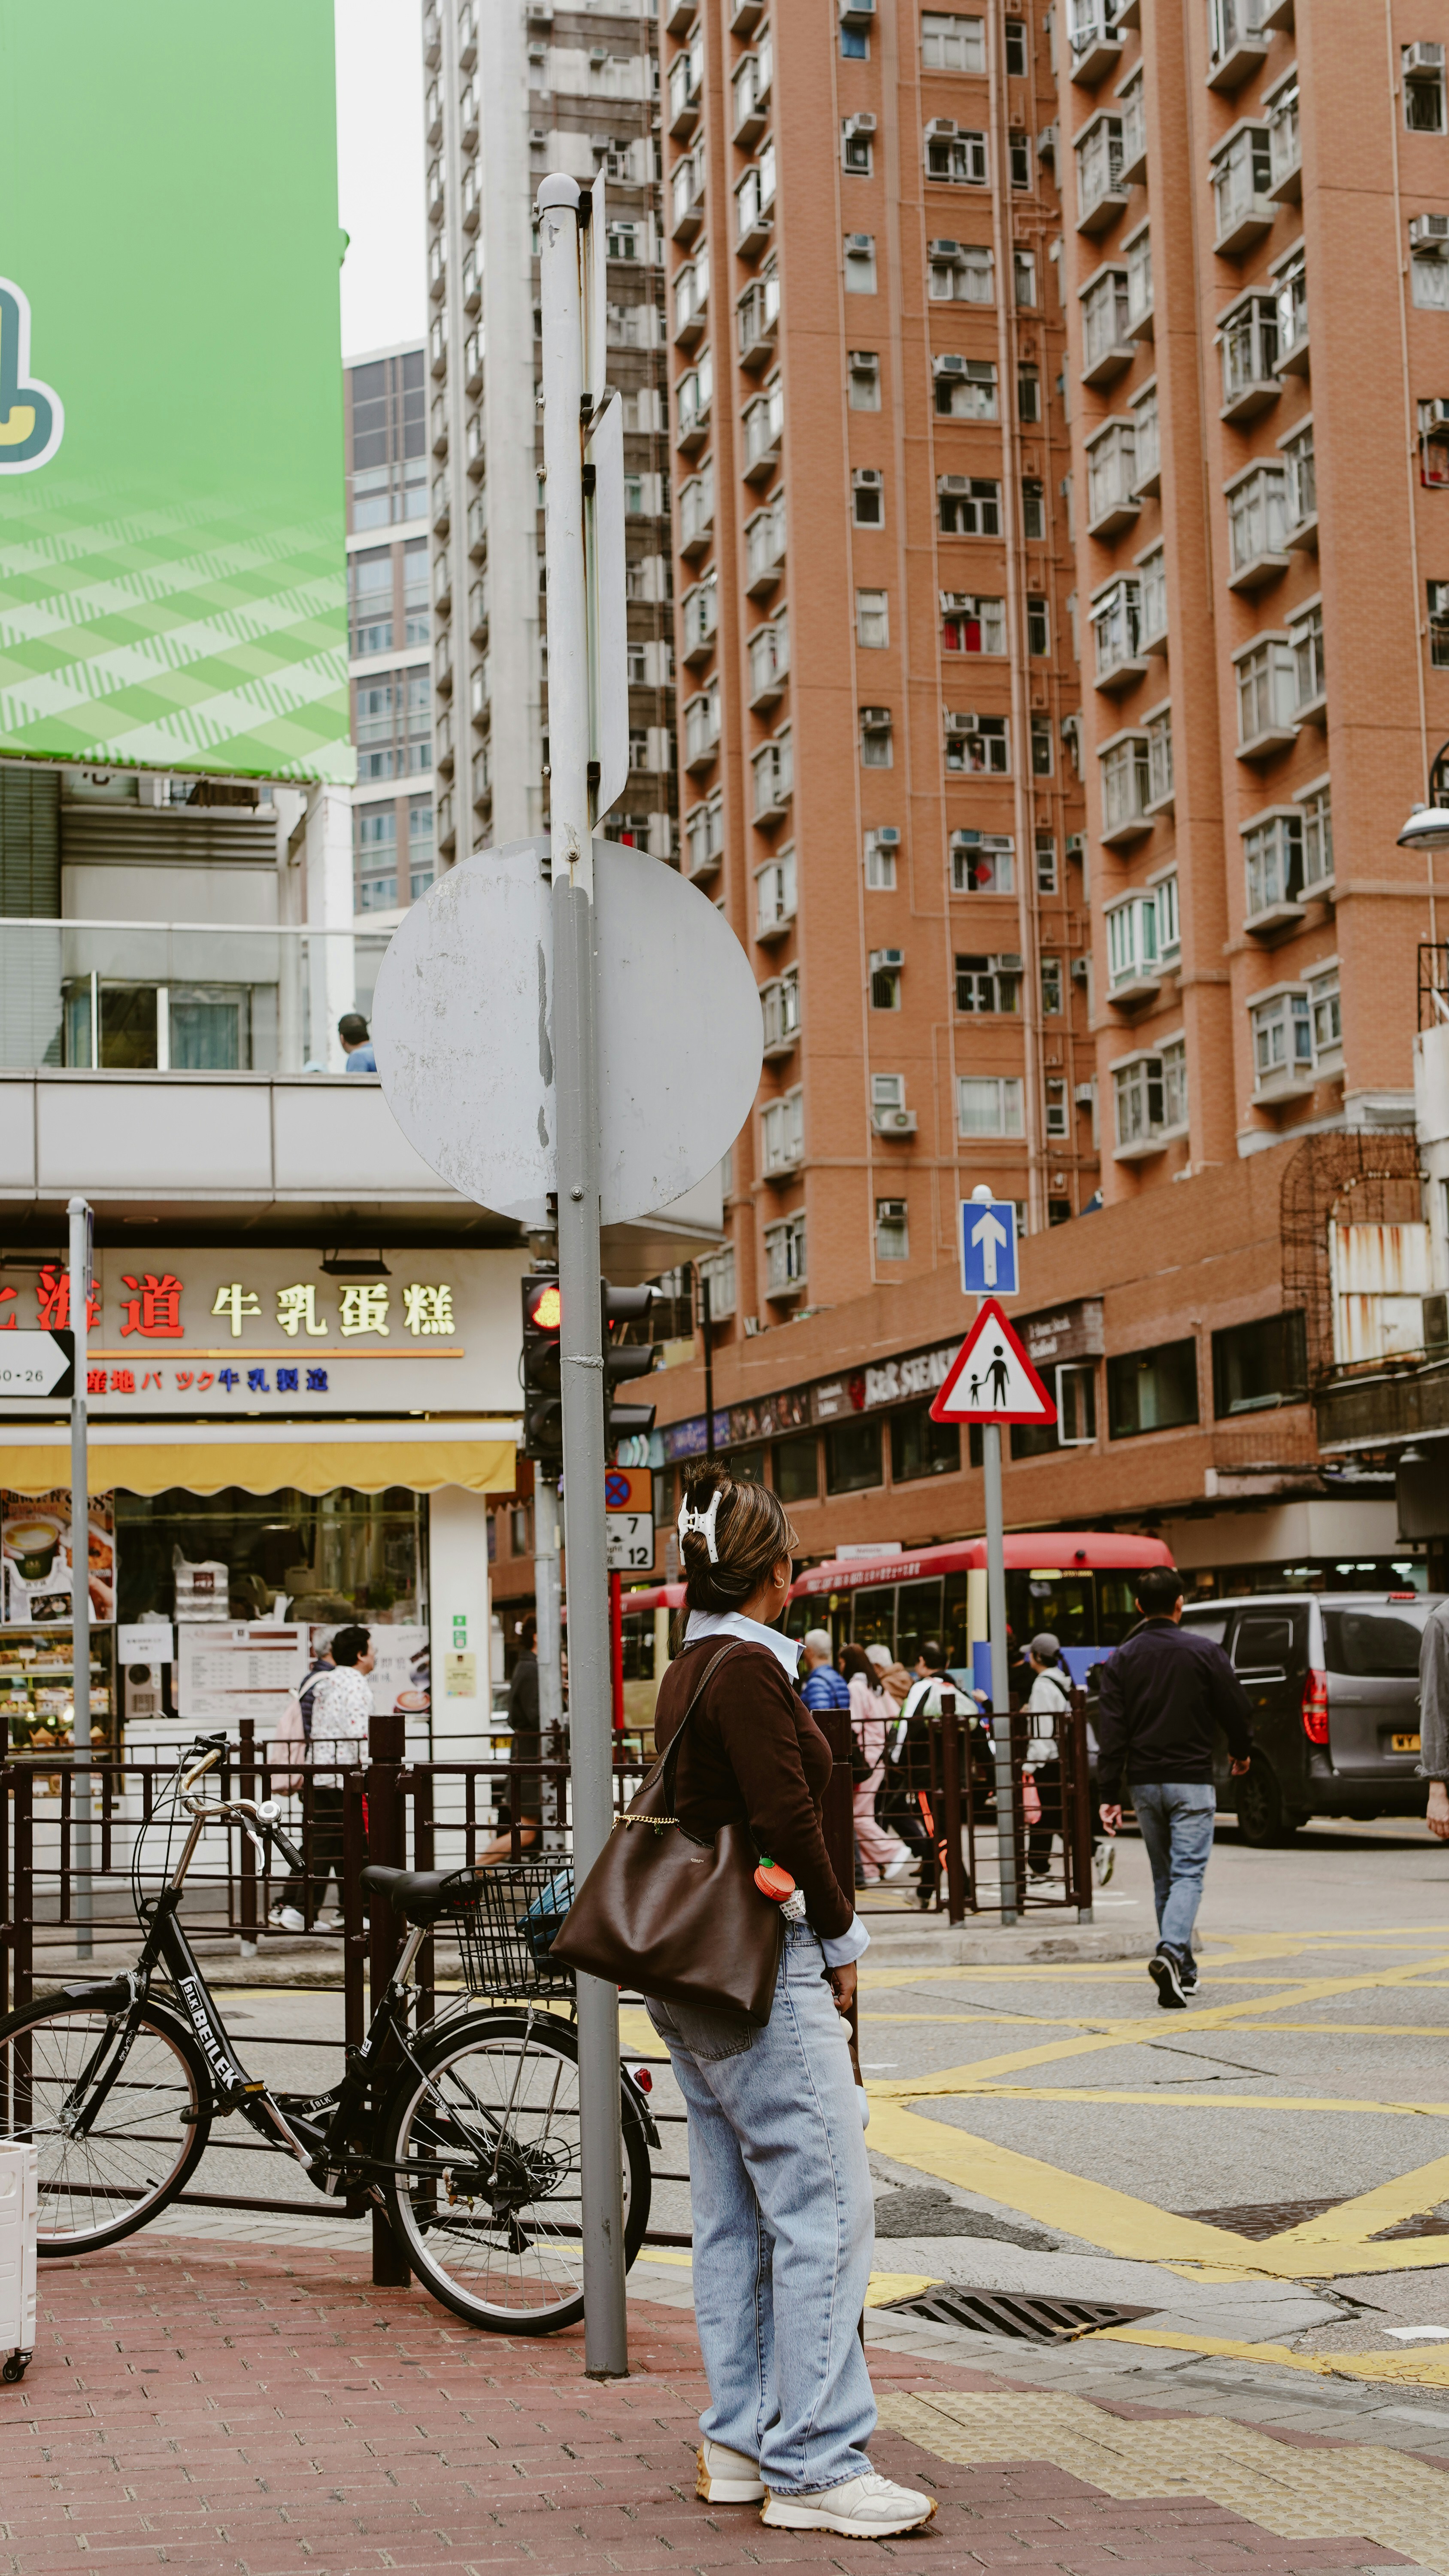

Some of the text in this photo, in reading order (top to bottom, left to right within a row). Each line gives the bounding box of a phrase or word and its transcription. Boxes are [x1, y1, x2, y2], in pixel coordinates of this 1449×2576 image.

[628, 1517, 638, 1534] 7
[629, 1547, 648, 1564] 12
[191, 2008, 240, 2090] BEILEK
